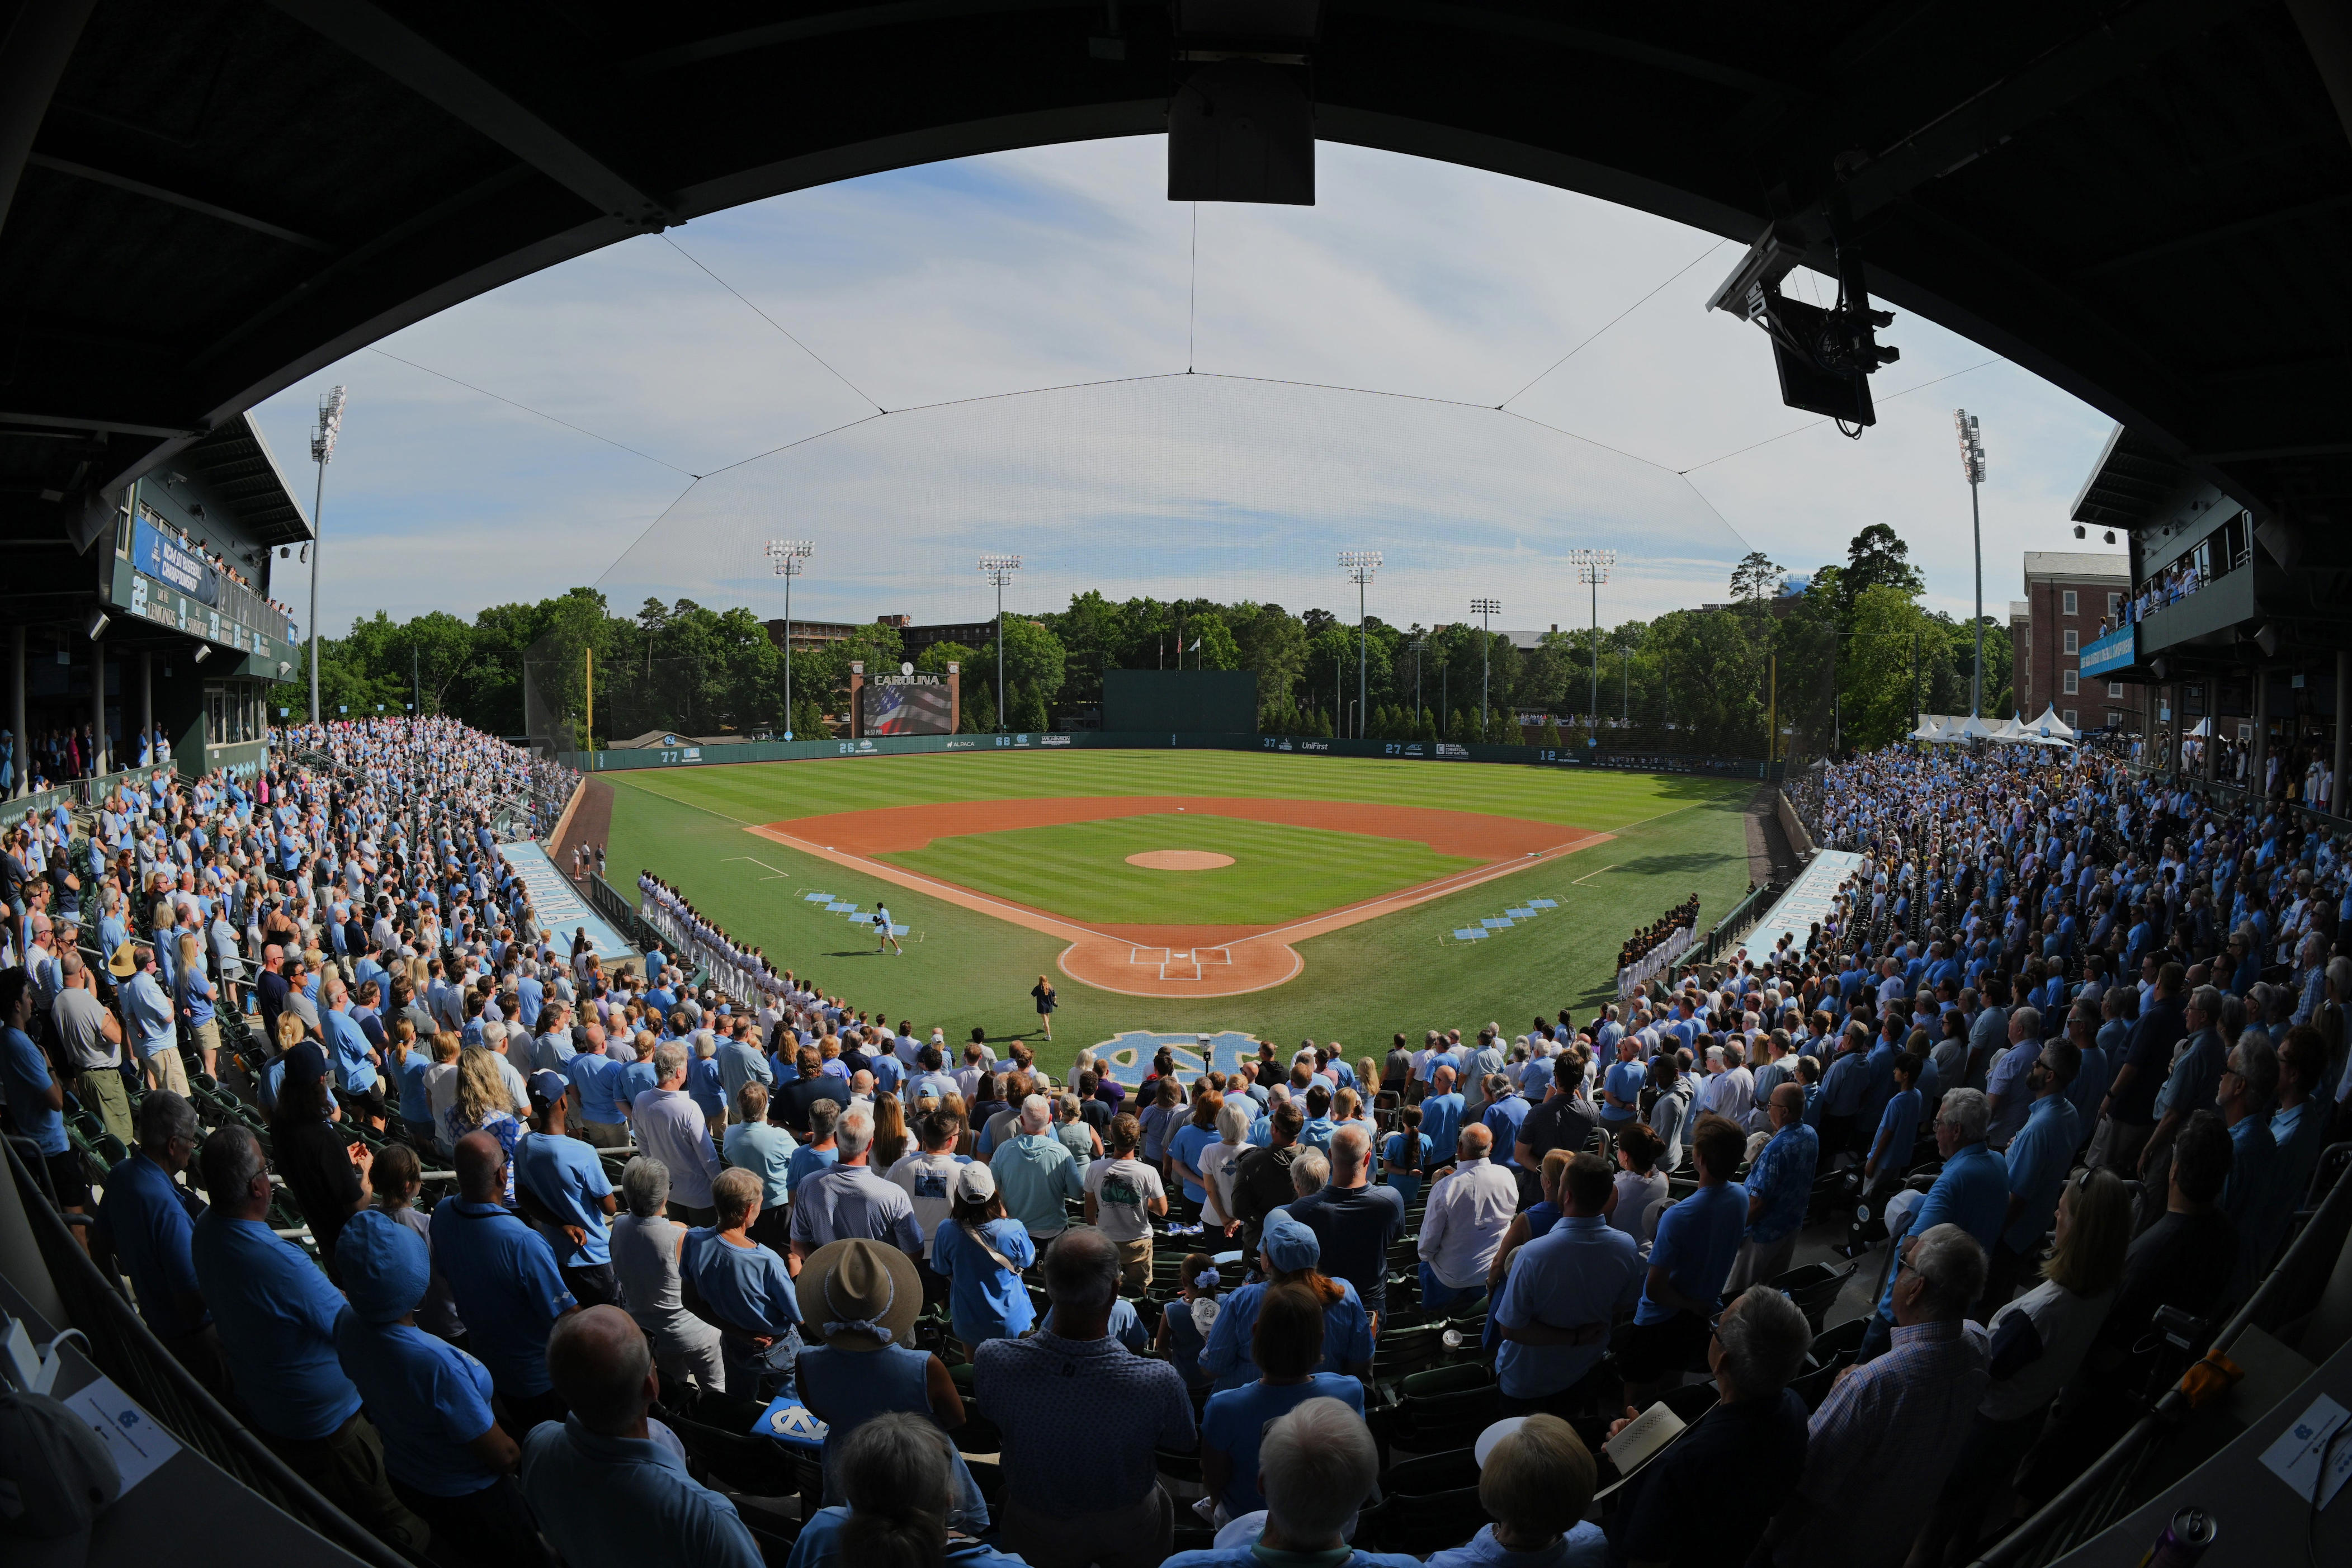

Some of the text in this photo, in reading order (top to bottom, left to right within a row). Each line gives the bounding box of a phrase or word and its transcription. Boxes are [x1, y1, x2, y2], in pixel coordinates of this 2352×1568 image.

[163, 542, 177, 564] NCAA
[182, 556, 202, 580] BASEBALL
[162, 560, 197, 592] CHAMPIONSHIP
[131, 575, 148, 617] 22
[157, 588, 169, 604] DAVE
[147, 601, 176, 627] LEMONDS
[180, 598, 186, 631] 9
[210, 612, 219, 641] 33
[874, 676, 940, 686] CAROLINA
[839, 743, 854, 753] 26
[995, 736, 1010, 746] 68
[1264, 738, 1276, 747] 37
[1302, 742, 1329, 750] UniFirst
[1386, 744, 1401, 754] 27
[661, 751, 678, 763] 77
[1541, 750, 1556, 761] 12
[510, 858, 592, 926] CAROLINA
[1765, 865, 1855, 932] TAR HEELS
